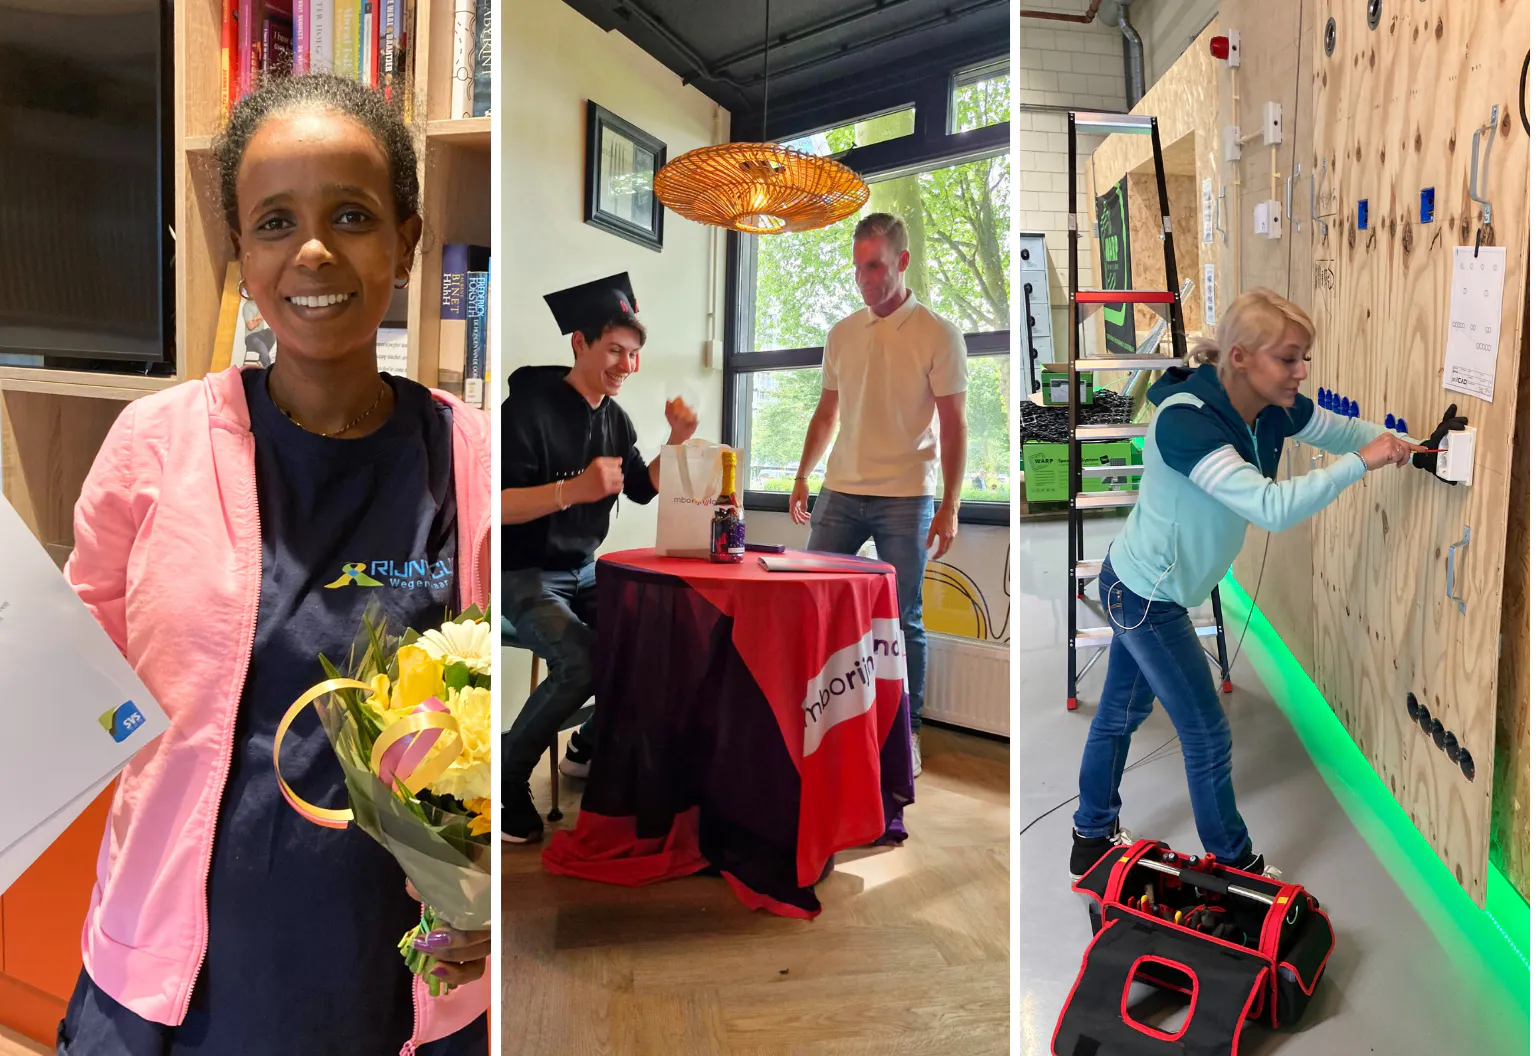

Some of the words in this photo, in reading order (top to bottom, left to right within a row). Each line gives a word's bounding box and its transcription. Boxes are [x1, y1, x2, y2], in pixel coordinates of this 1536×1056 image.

[442, 273, 452, 306] HhhH
[450, 273, 461, 314] BINET
[468, 277, 479, 318] FORSYTH
[477, 277, 487, 317] FREDERICK
[123, 712, 141, 729] SVS
